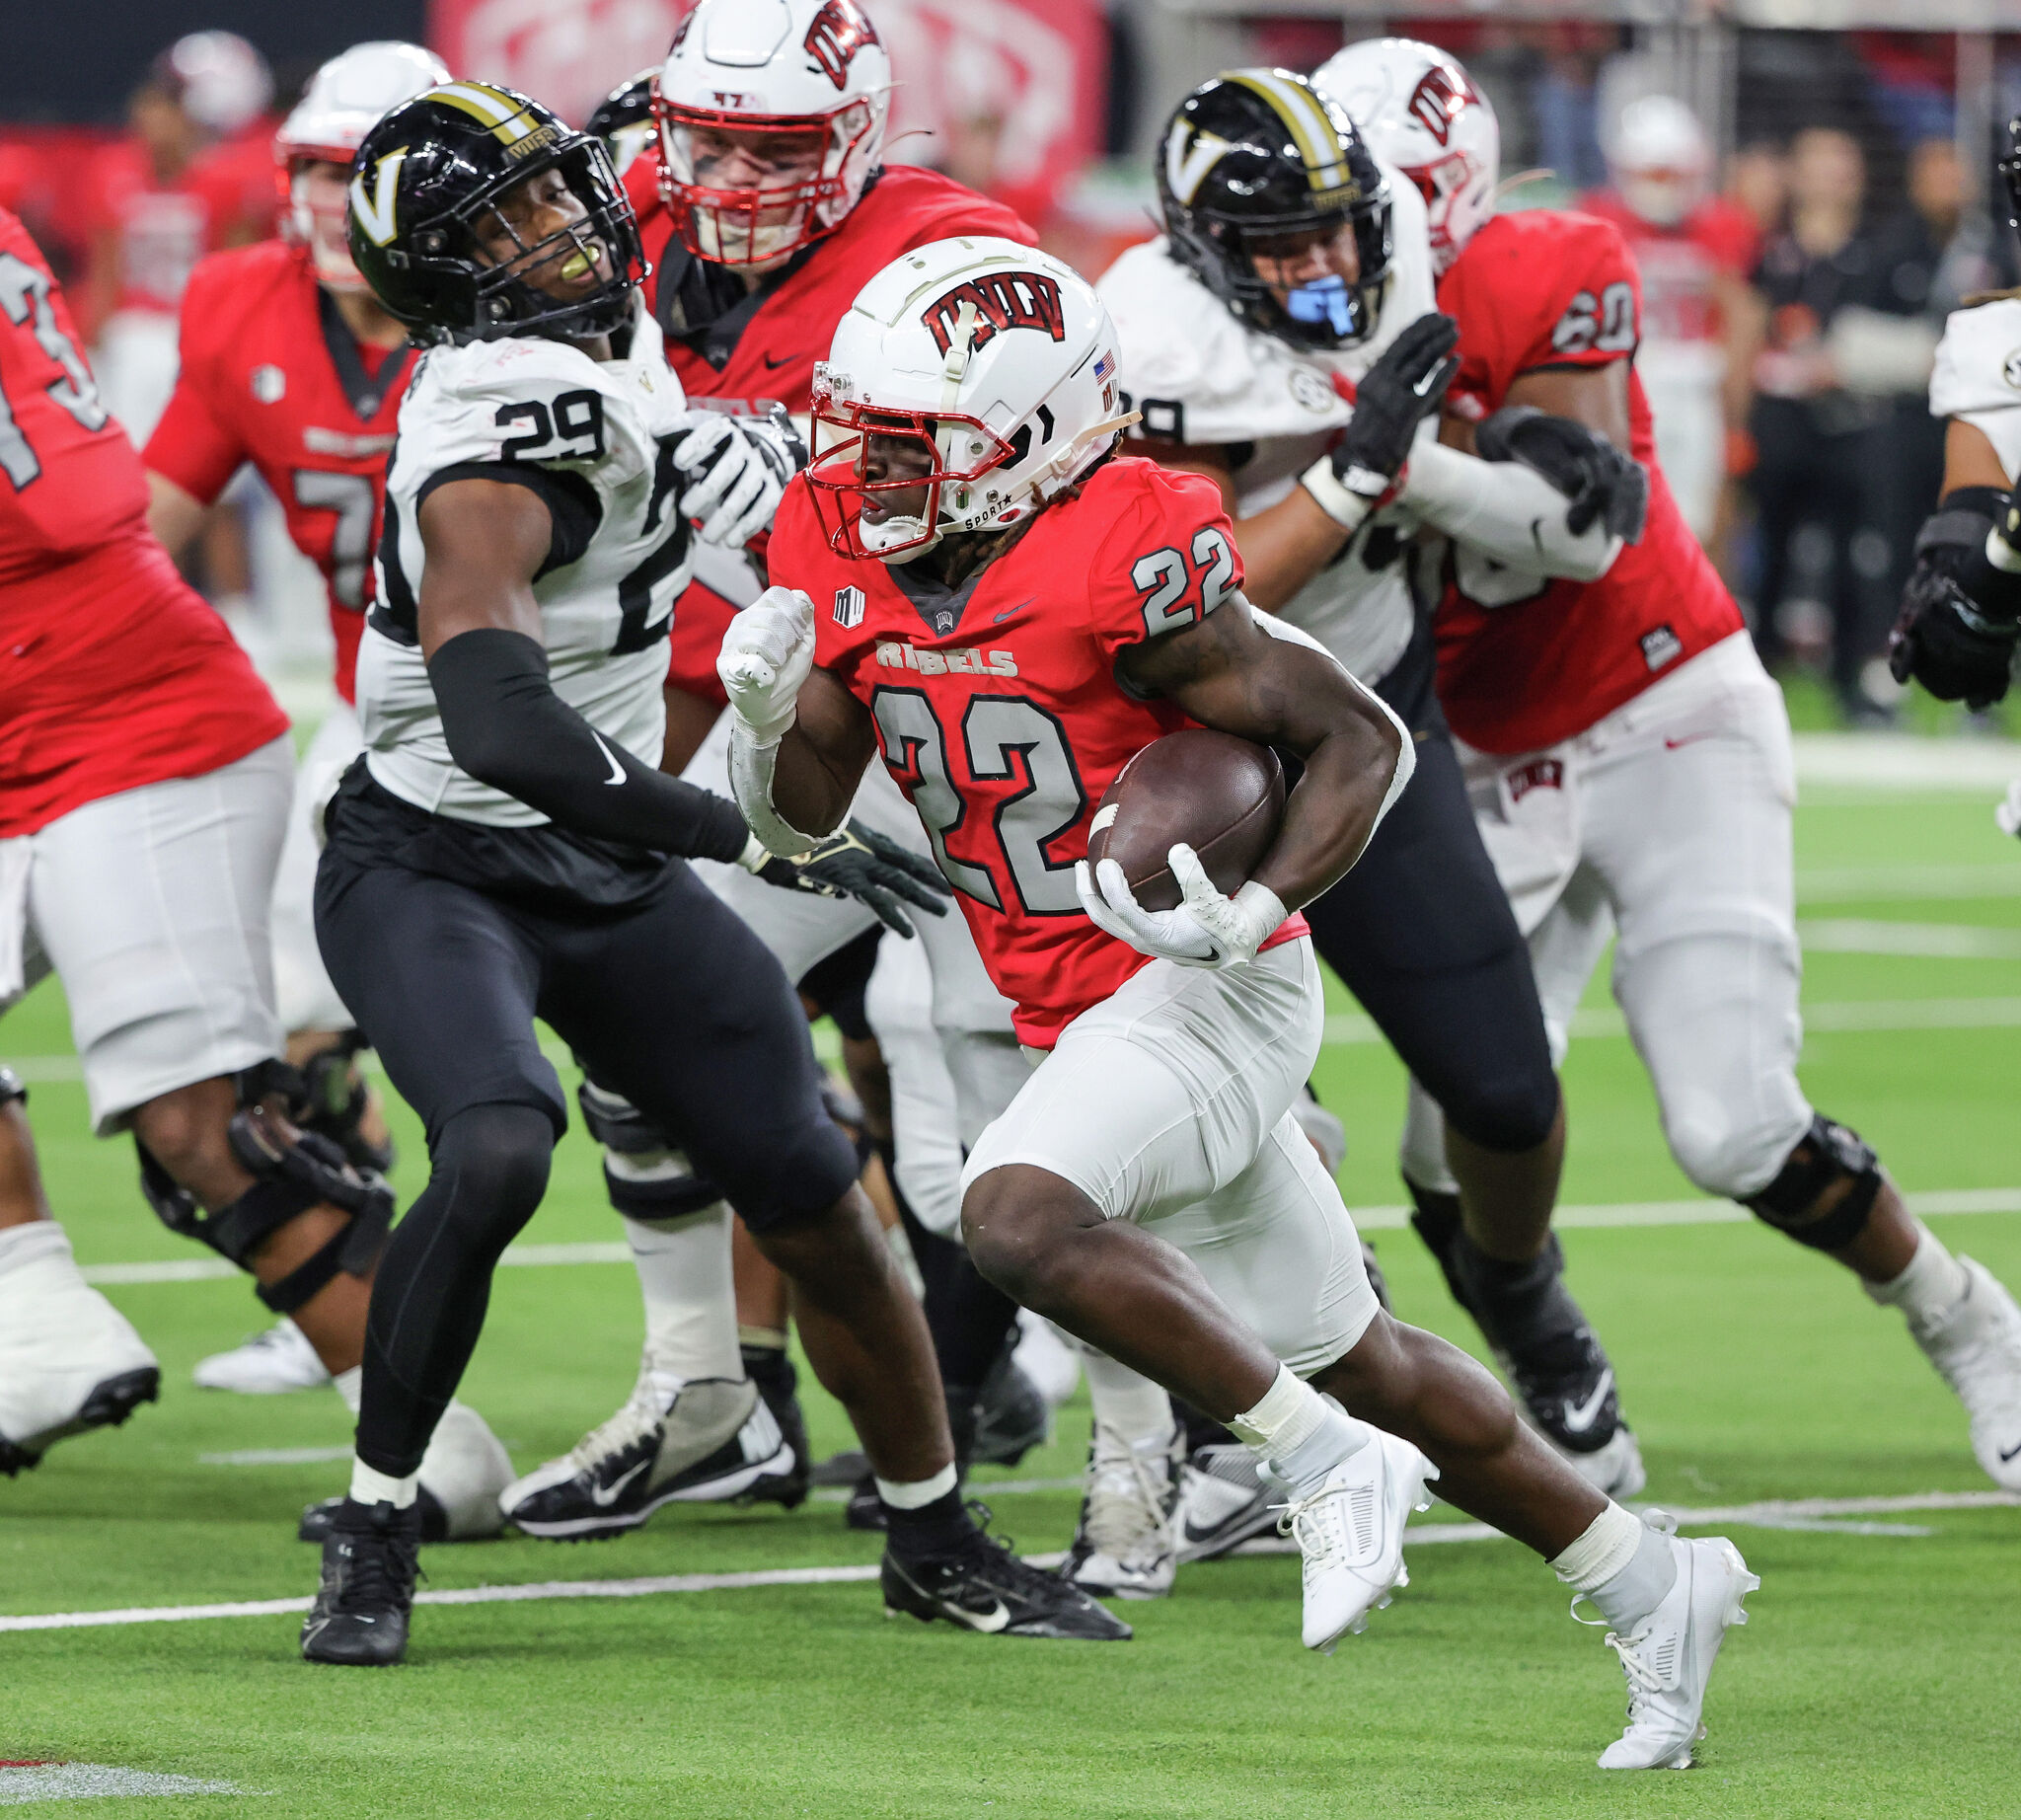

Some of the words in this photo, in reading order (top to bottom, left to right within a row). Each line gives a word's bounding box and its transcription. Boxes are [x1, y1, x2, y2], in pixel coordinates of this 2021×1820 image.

[920, 270, 1066, 365] UNLV
[494, 389, 606, 462] 29
[964, 499, 1005, 530] SPORT
[1129, 525, 1239, 638] 22
[870, 683, 1090, 917] 22
